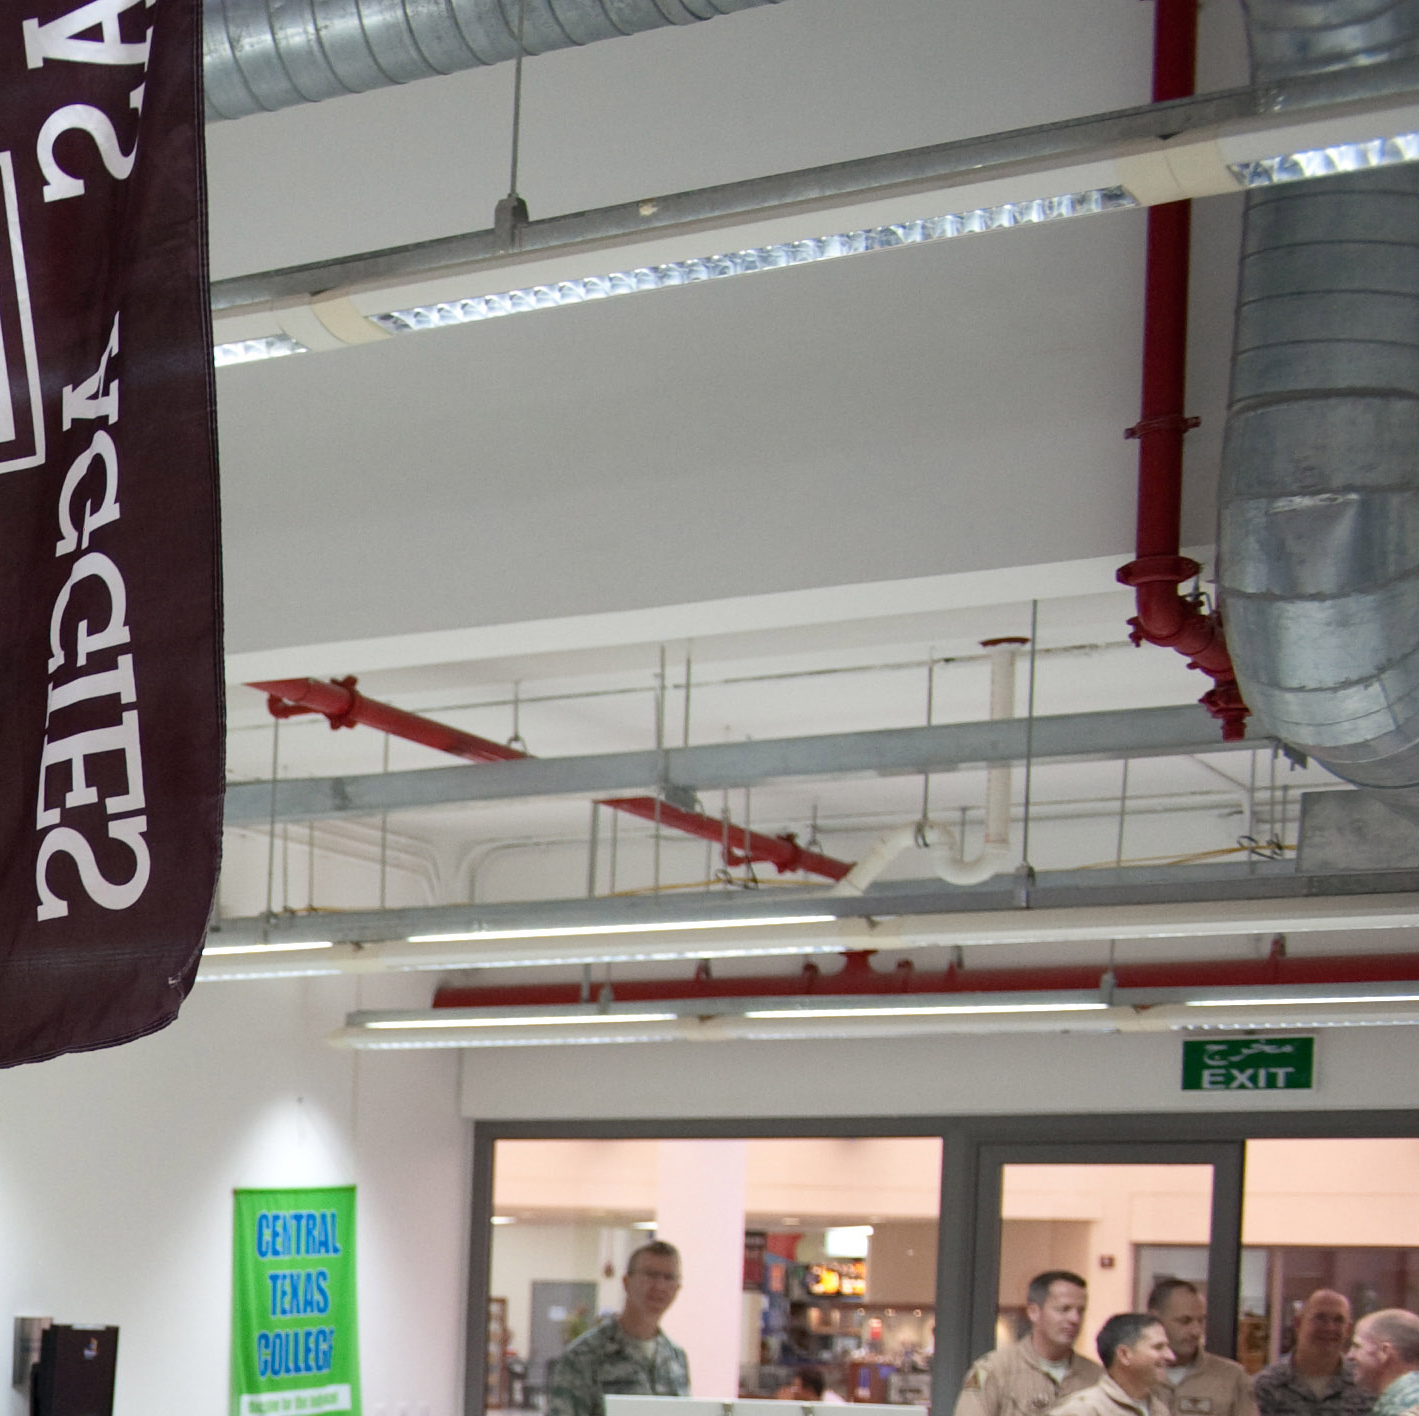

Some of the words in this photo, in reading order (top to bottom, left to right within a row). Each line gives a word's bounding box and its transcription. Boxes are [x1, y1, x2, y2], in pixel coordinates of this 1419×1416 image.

[1201, 1067, 1295, 1089] EXIT
[256, 1211, 342, 1259] CENTRAL
[267, 1268, 330, 1319] TEXAS
